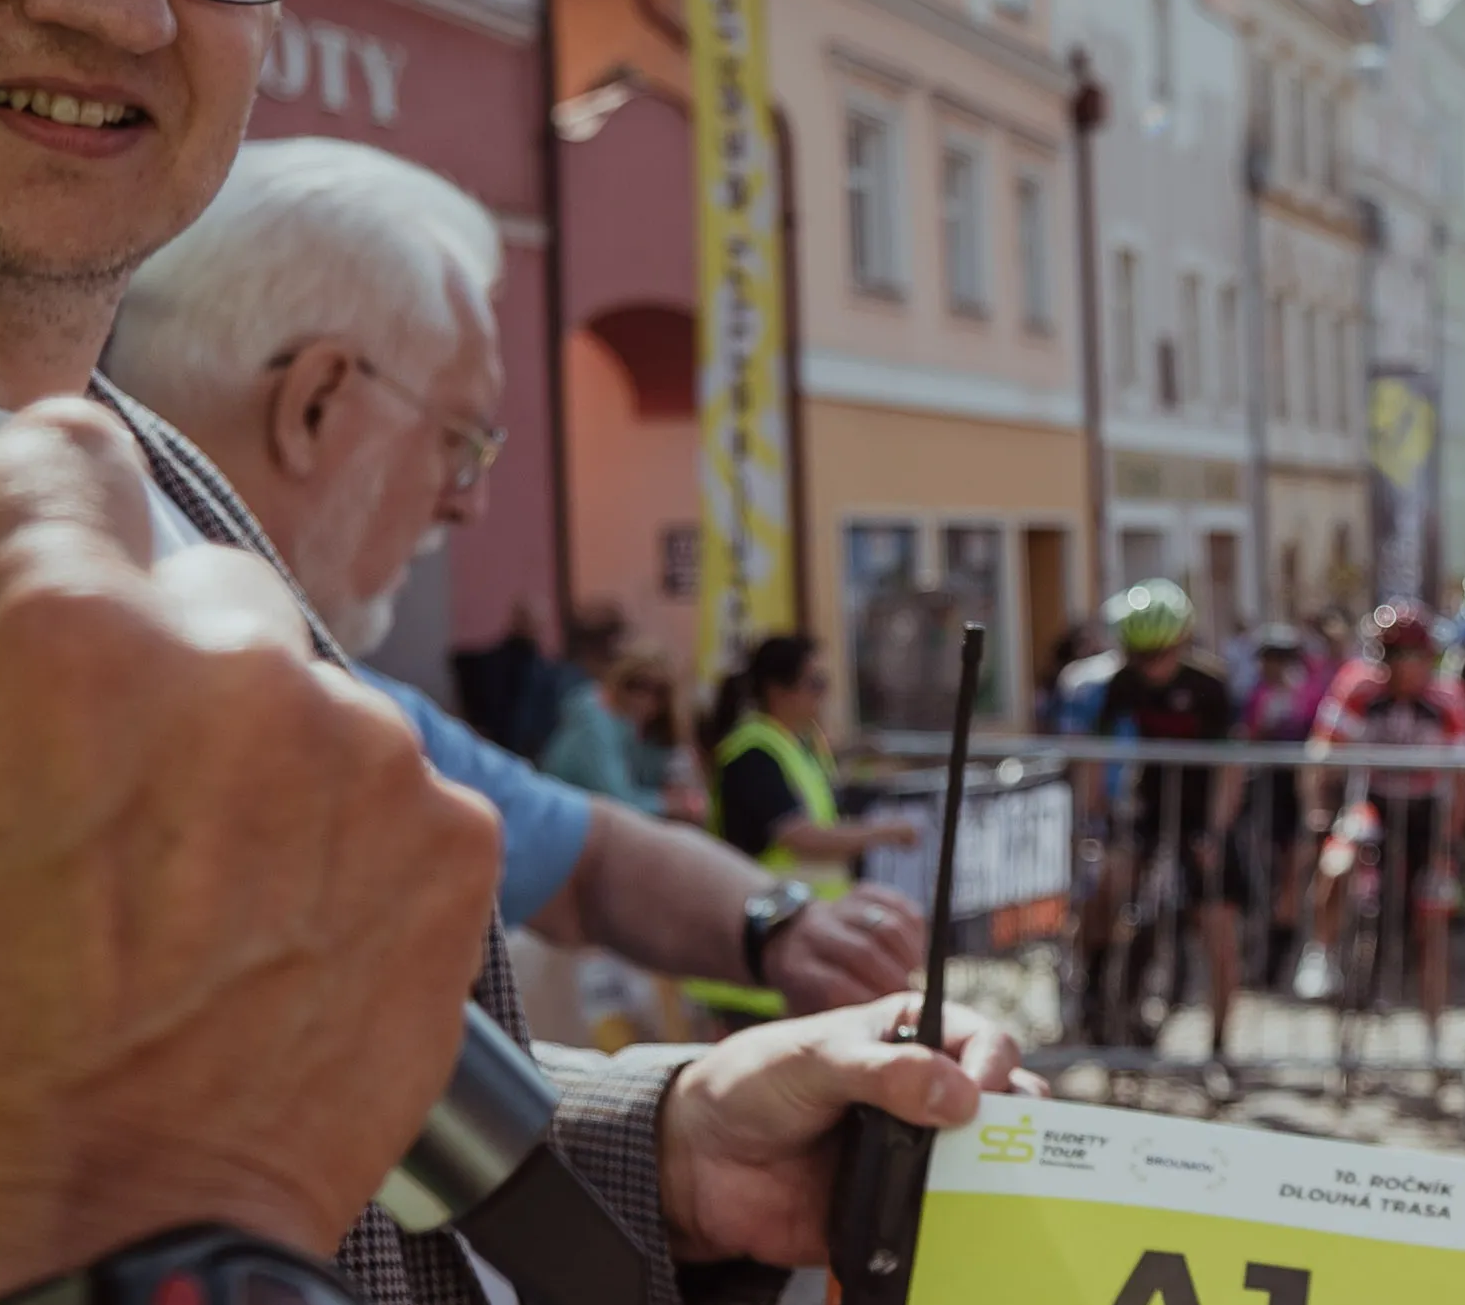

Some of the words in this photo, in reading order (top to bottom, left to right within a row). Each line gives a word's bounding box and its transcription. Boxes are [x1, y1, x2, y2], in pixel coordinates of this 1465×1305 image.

[1369, 1172, 1454, 1197] ROČNÍK
[1279, 1182, 1372, 1210] DLOUHÁ
[1380, 1196, 1451, 1220] TRASA
